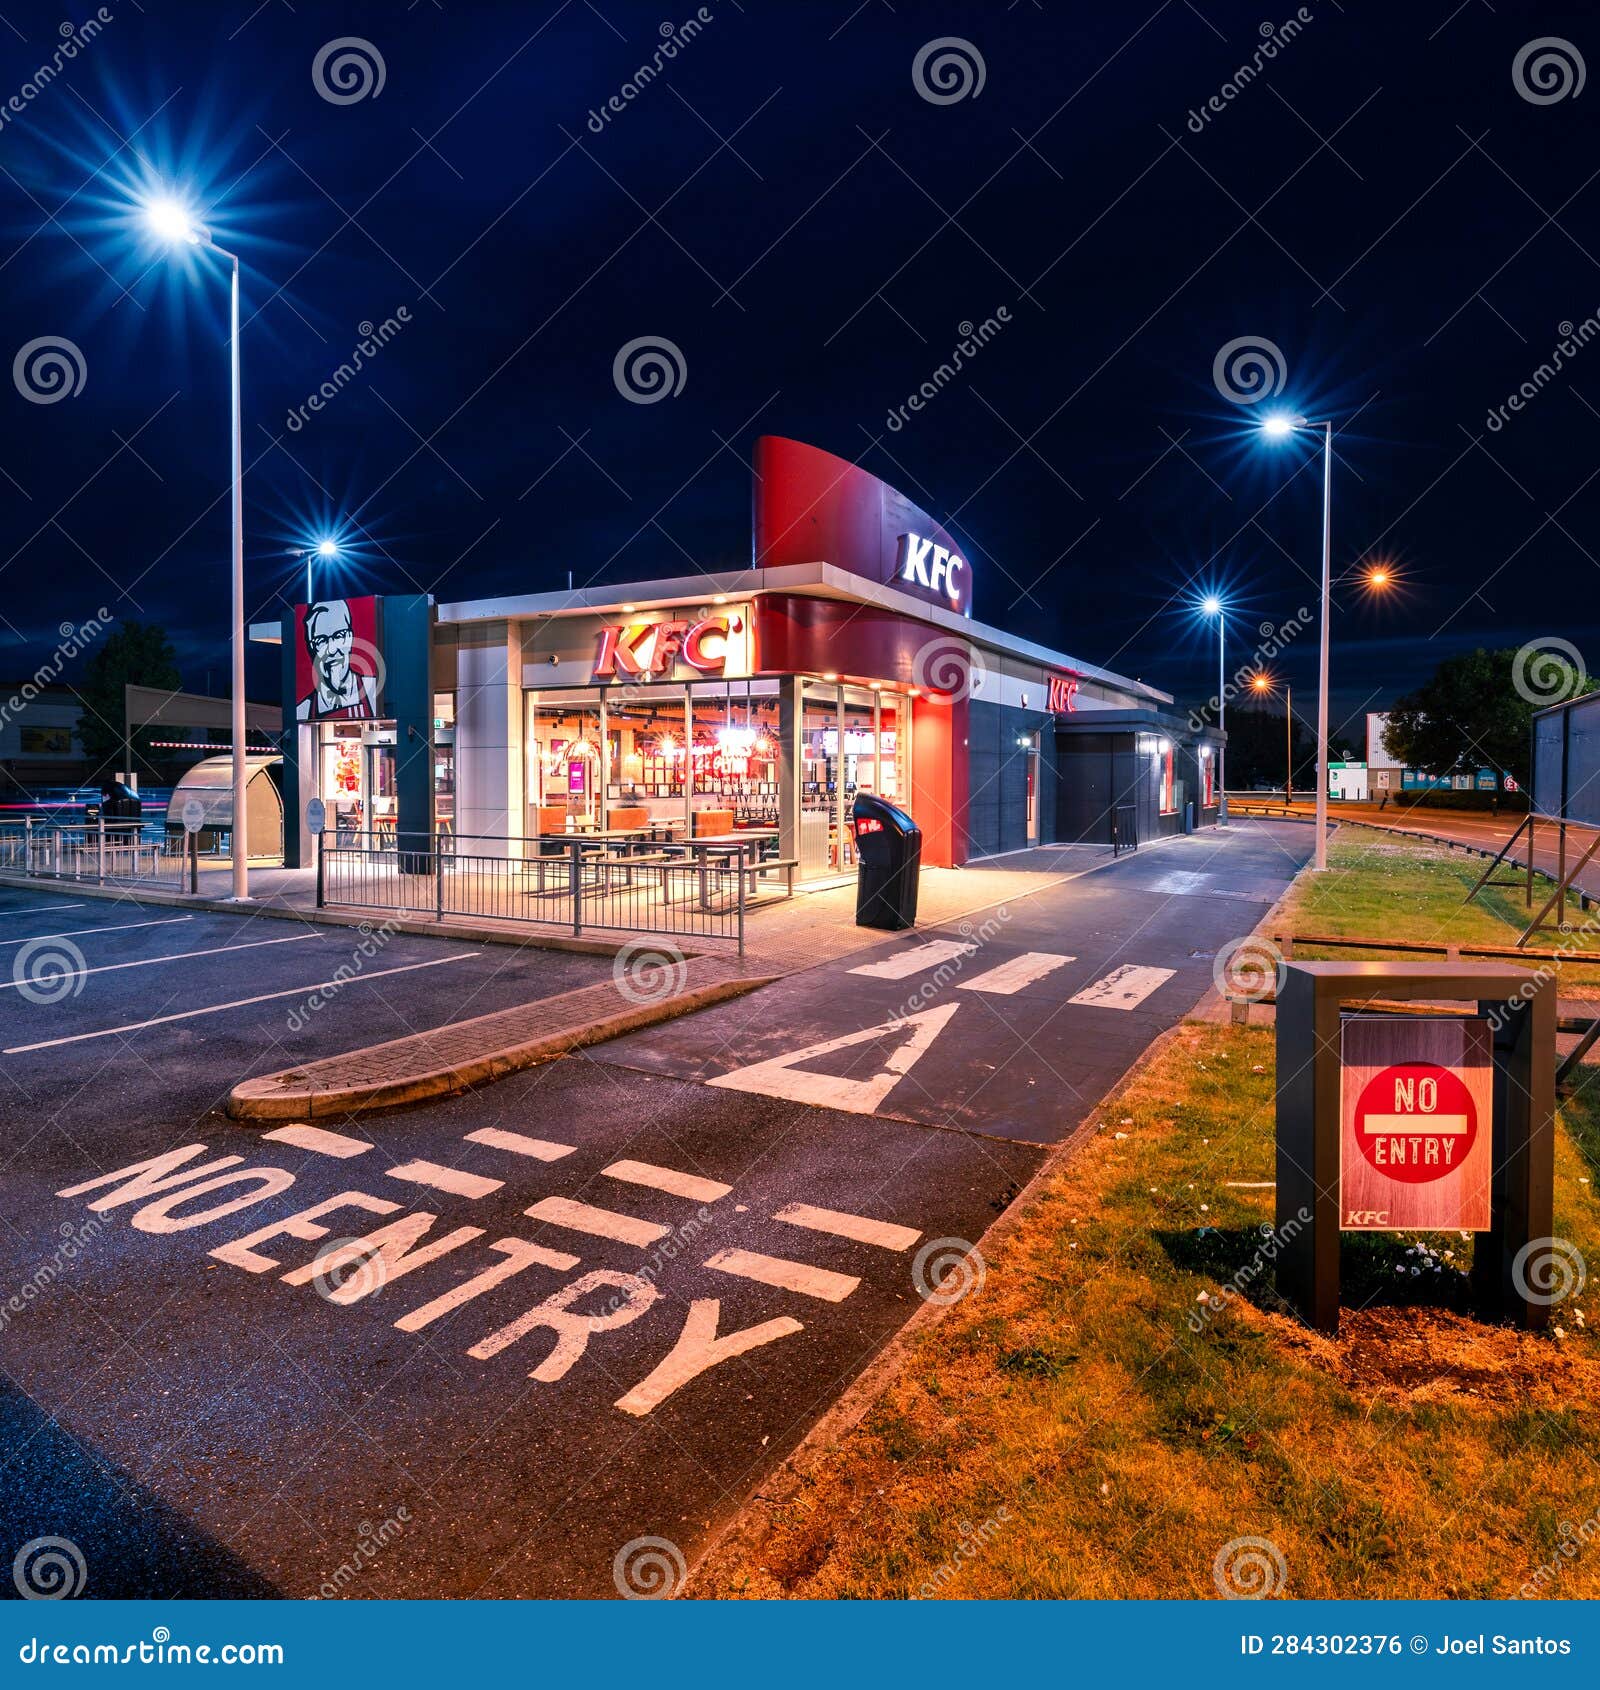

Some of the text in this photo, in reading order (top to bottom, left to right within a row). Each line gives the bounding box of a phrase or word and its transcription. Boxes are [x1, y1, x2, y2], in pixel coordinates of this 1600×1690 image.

[903, 532, 964, 600] KFC
[593, 617, 730, 676] KFC
[1047, 677, 1079, 713] KFC
[1394, 1077, 1438, 1114] NO
[1375, 1137, 1456, 1165] ENTRY
[1345, 1210, 1389, 1225] KFC
[56, 1144, 803, 1417] NO ENTRY
